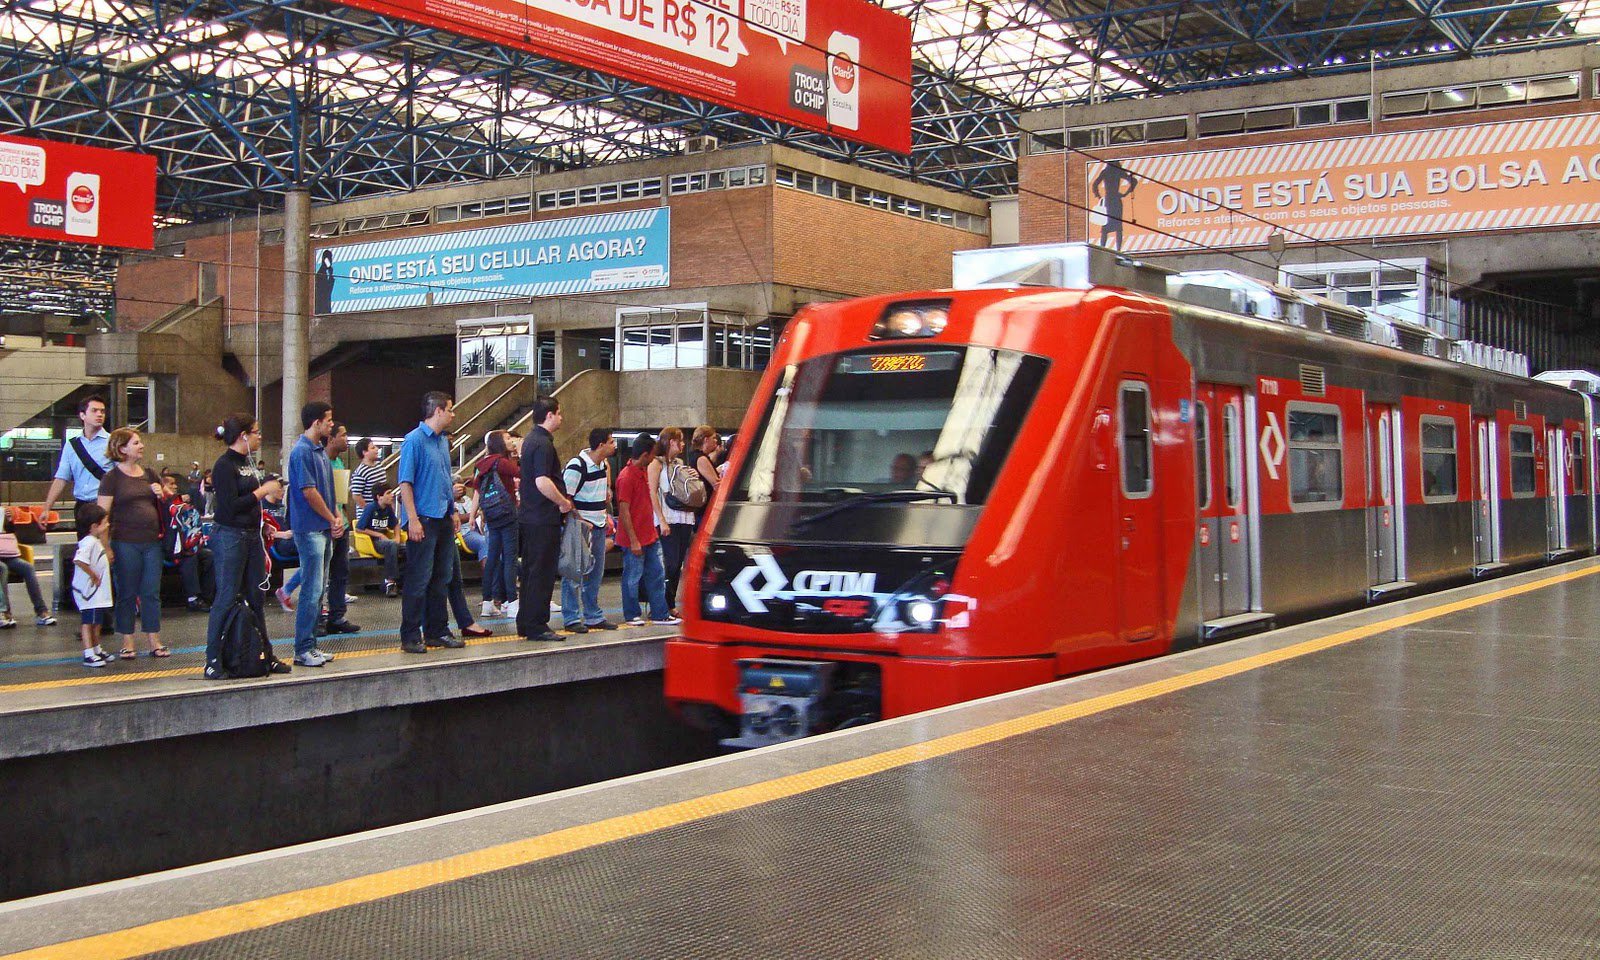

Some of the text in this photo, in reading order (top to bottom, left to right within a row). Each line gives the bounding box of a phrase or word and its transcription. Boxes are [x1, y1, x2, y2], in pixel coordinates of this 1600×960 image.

[618, 0, 730, 53] DE R$ 12
[749, 3, 780, 29] TODO
[781, 15, 800, 37] DIA
[794, 71, 825, 94] TROCA
[832, 64, 853, 80] Claro
[794, 88, 825, 110] O CHIP
[1156, 183, 1243, 216] ONDE
[1252, 170, 1336, 208] ESTÁ
[1343, 170, 1414, 201] SUA
[1426, 158, 1549, 195] BOLSA
[33, 202, 64, 216] TROCA
[33, 213, 64, 227] O CHIP
[1157, 197, 1453, 229] Reforce a atenção com os seus objetos pessoais.
[349, 235, 647, 285] ONDE ESTÁ SEU CELULAR AGORA?
[349, 285, 374, 295] Reforce
[446, 276, 472, 288] objetos
